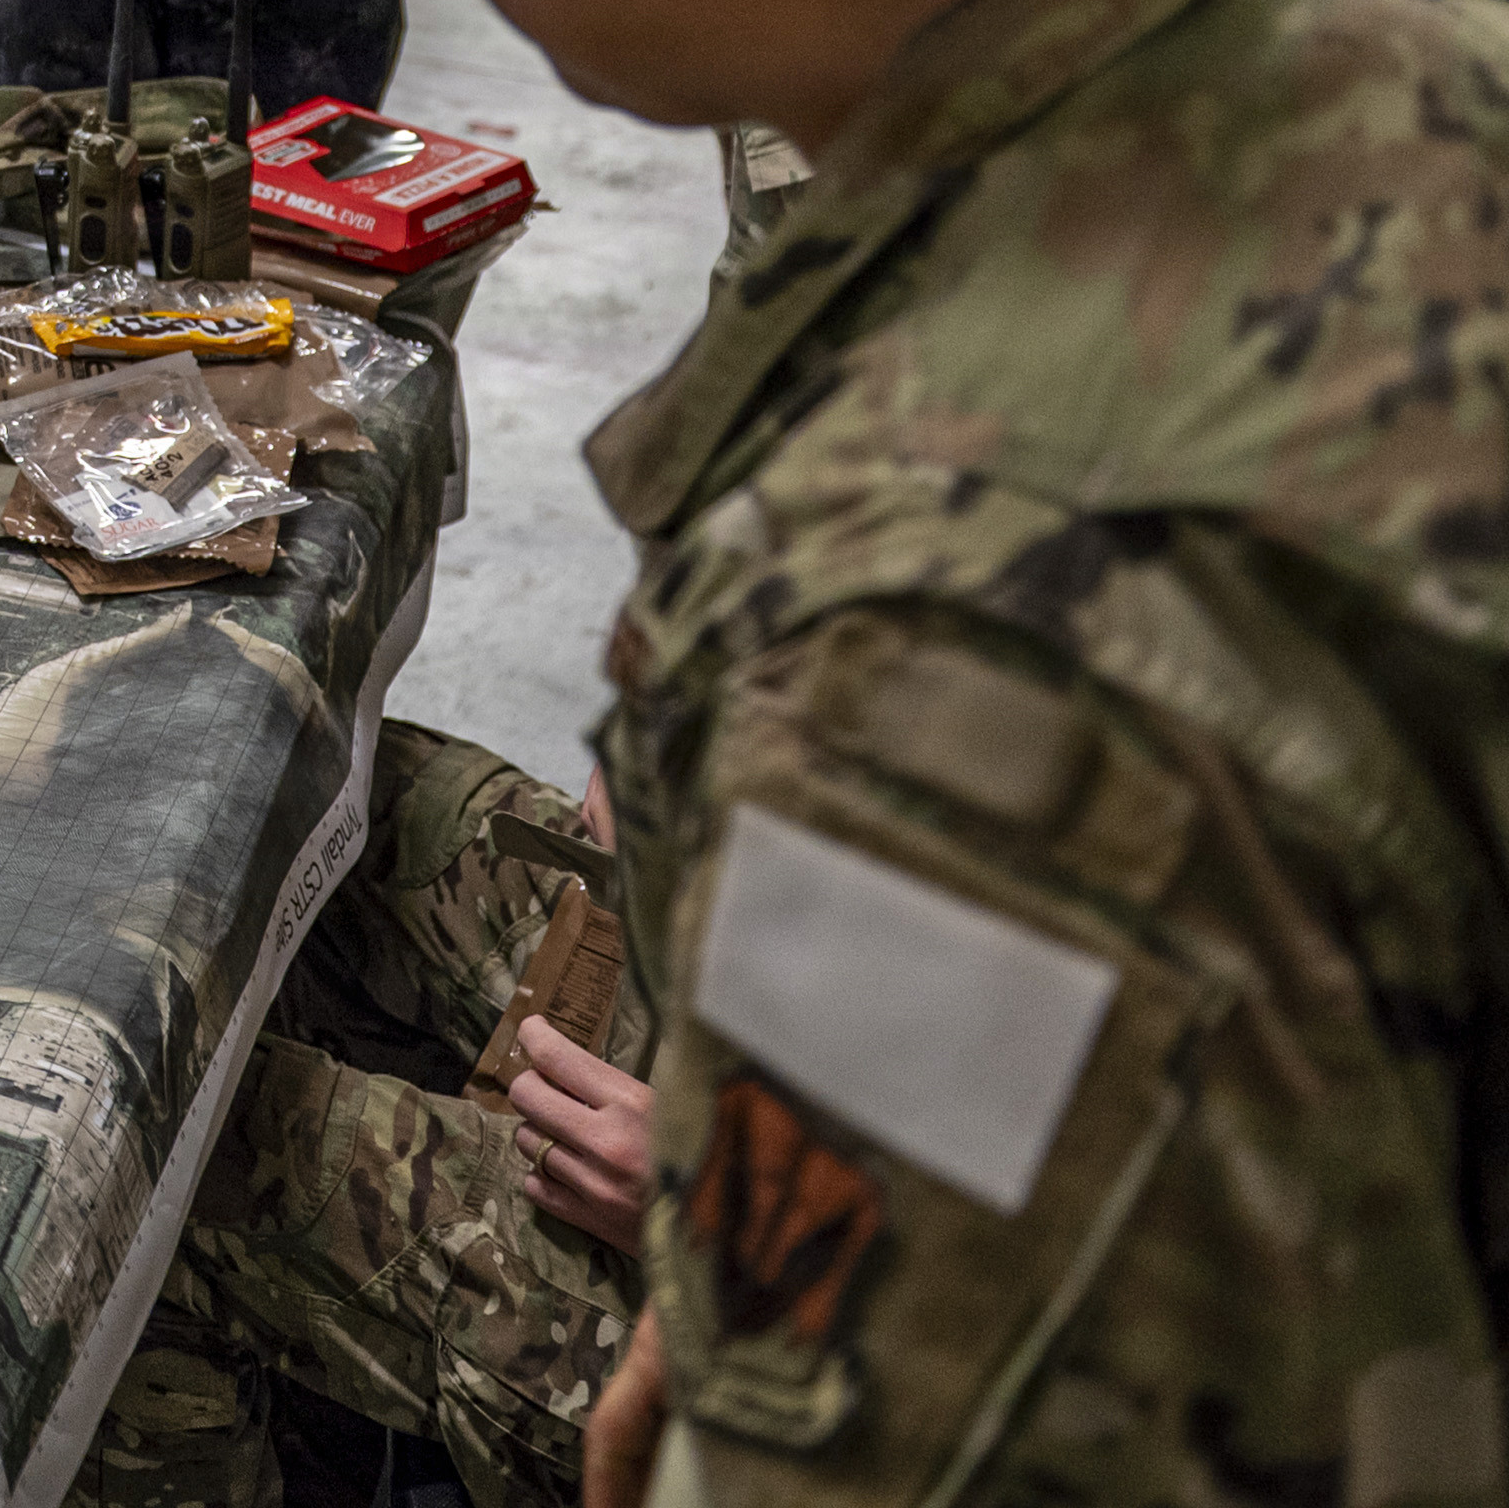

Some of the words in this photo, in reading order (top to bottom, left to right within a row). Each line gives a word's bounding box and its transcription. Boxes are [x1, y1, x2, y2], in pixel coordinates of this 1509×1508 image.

[252, 181, 283, 206] EST
[284, 189, 336, 221] MEAL
[339, 209, 376, 233] EVER
[101, 517, 161, 539] SUGAR
[321, 803, 363, 877] Tyndall
[290, 861, 323, 922] CSTR
